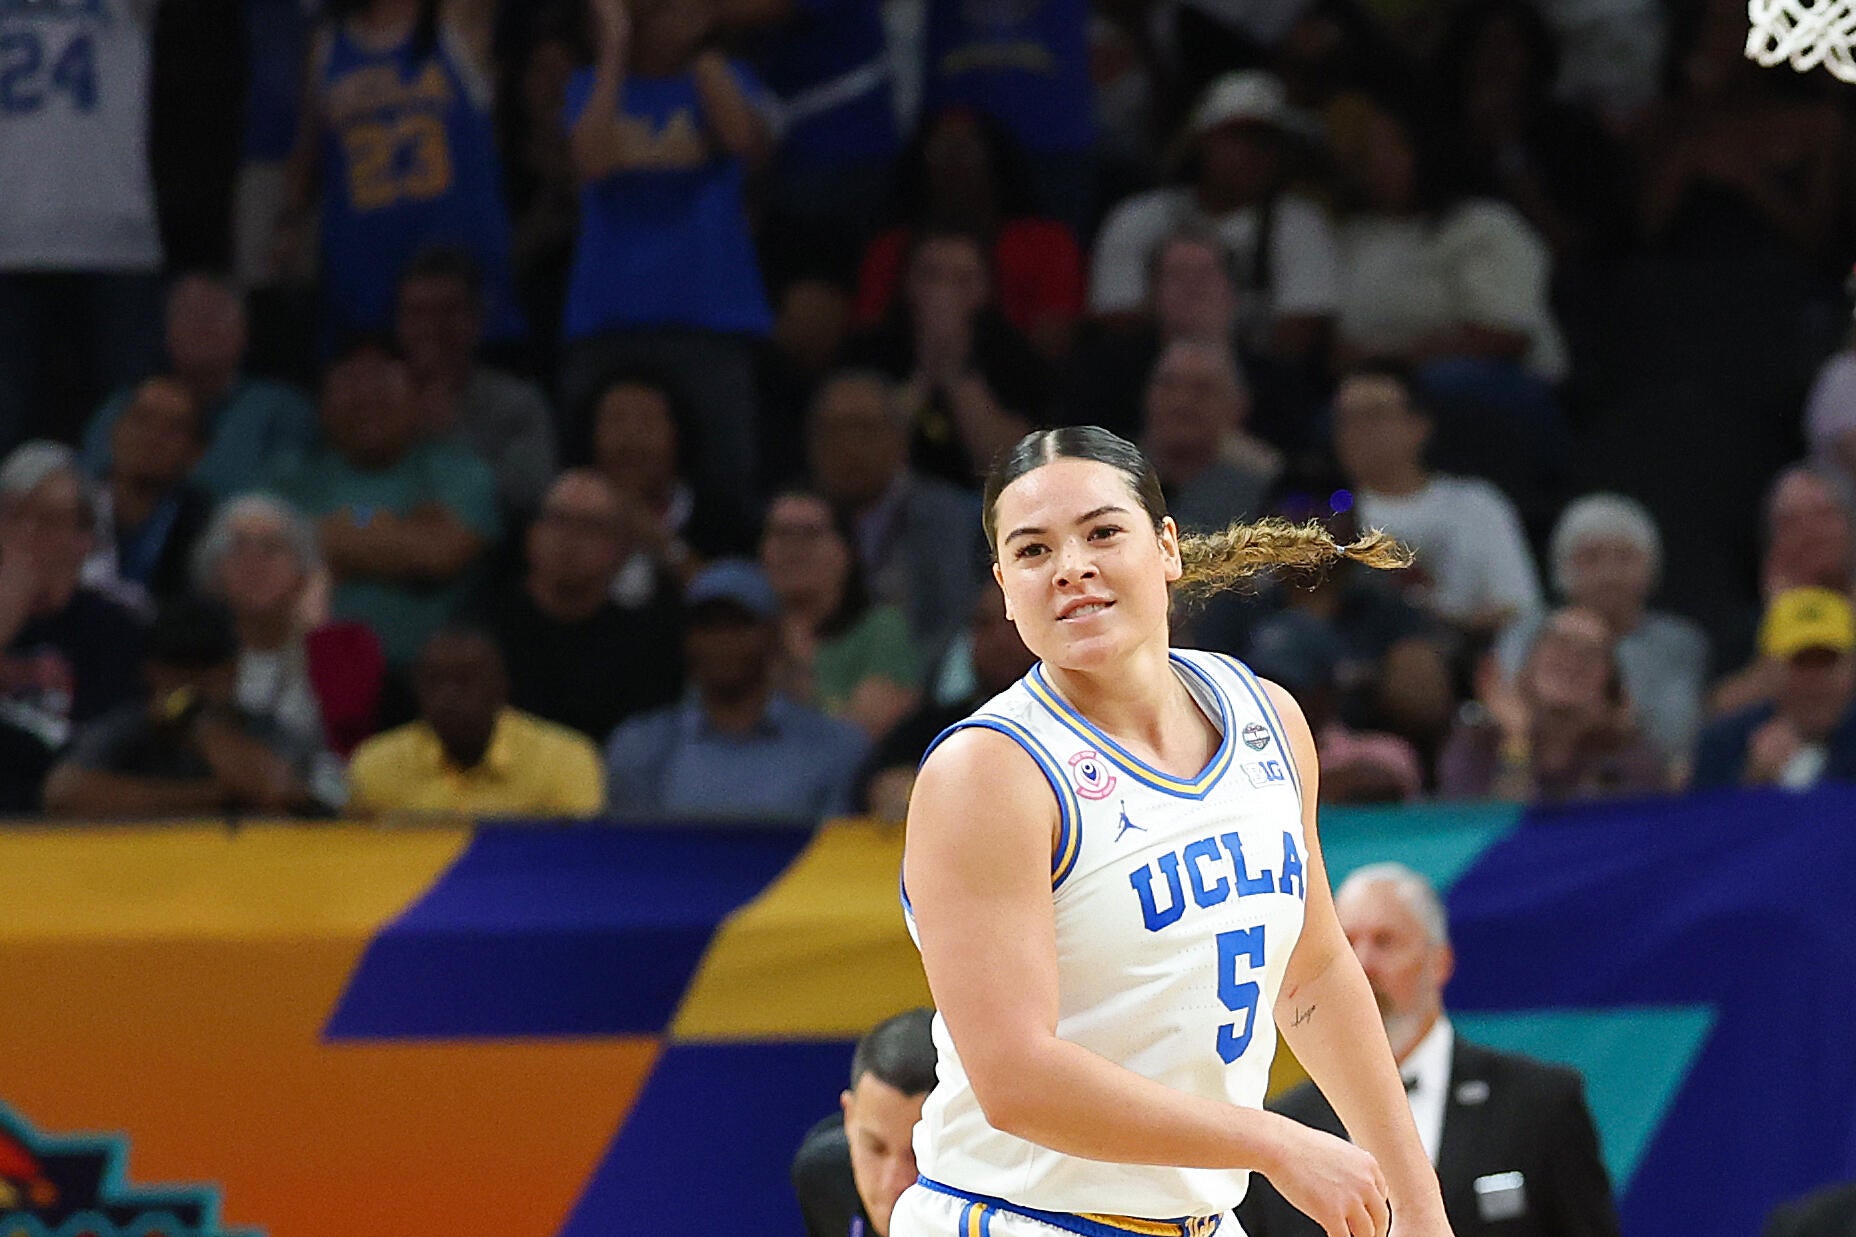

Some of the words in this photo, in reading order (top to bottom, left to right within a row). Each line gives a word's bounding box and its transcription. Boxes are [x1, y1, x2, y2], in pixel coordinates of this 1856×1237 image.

[345, 117, 449, 210] 23
[1128, 830, 1305, 933] UCLA
[1215, 924, 1266, 1065] 5
